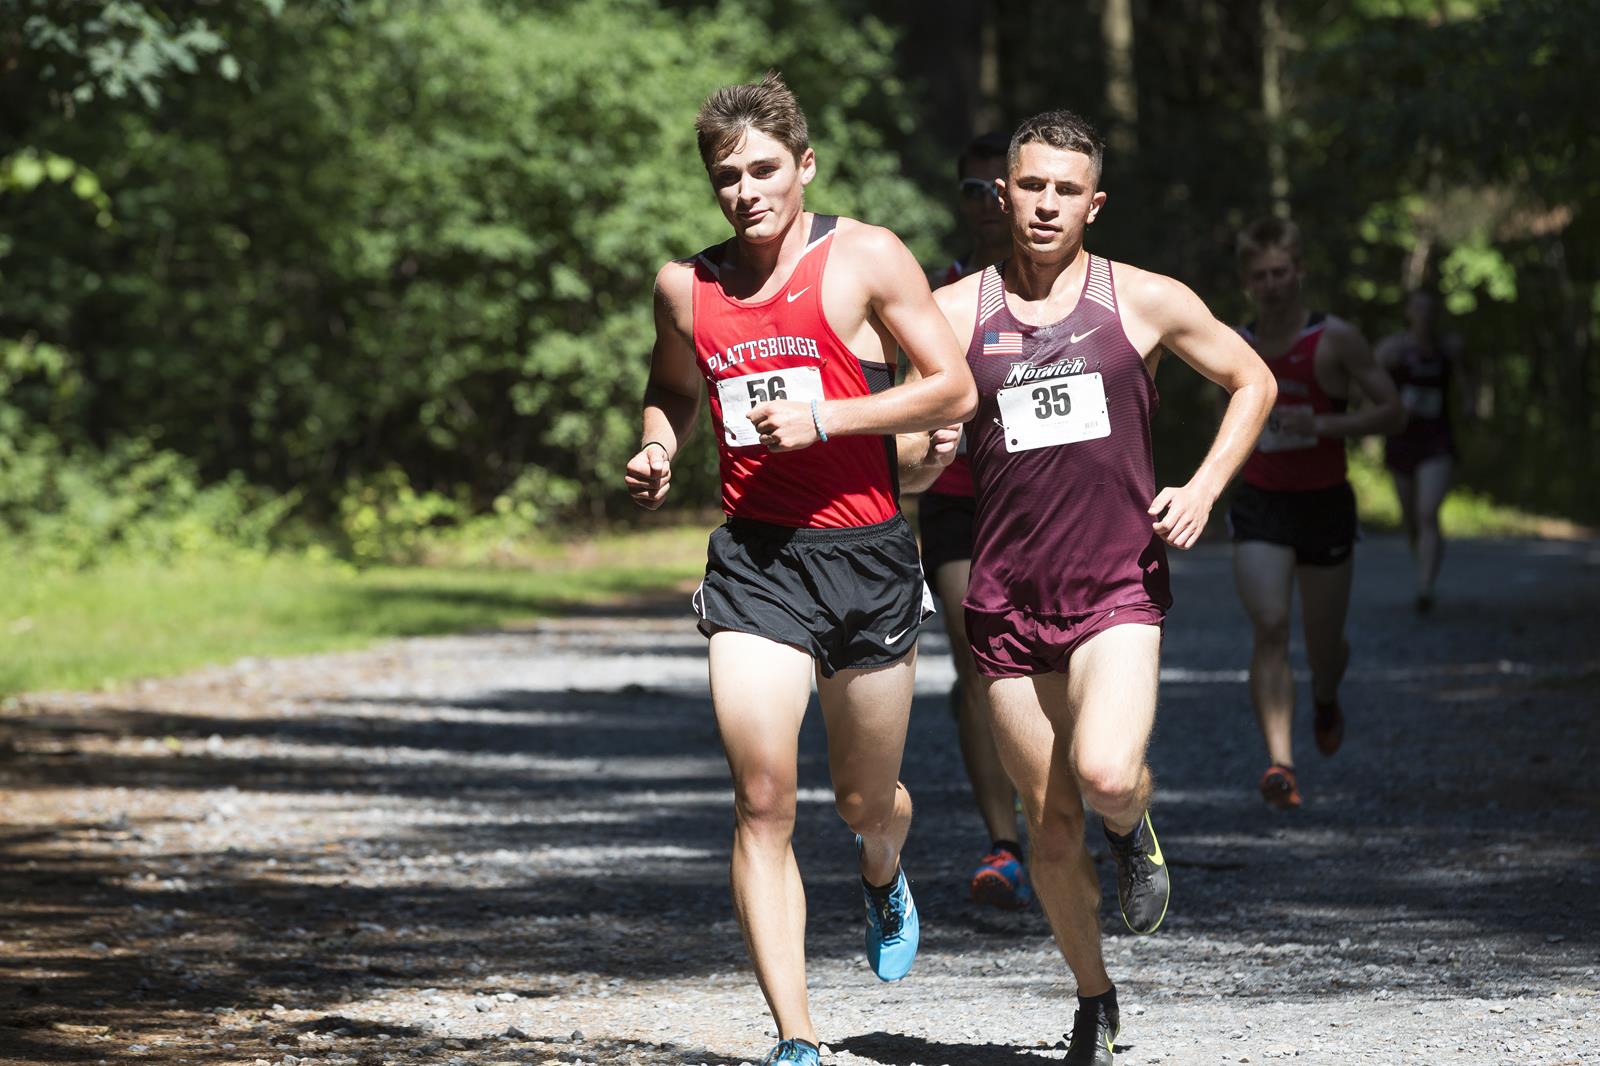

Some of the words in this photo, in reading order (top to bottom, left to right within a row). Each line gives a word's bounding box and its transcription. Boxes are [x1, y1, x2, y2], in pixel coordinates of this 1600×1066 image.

[706, 336, 820, 375] PLATTSBURGH
[1003, 357, 1087, 388] Norwich
[746, 375, 788, 409] 56
[1031, 383, 1072, 420] 35
